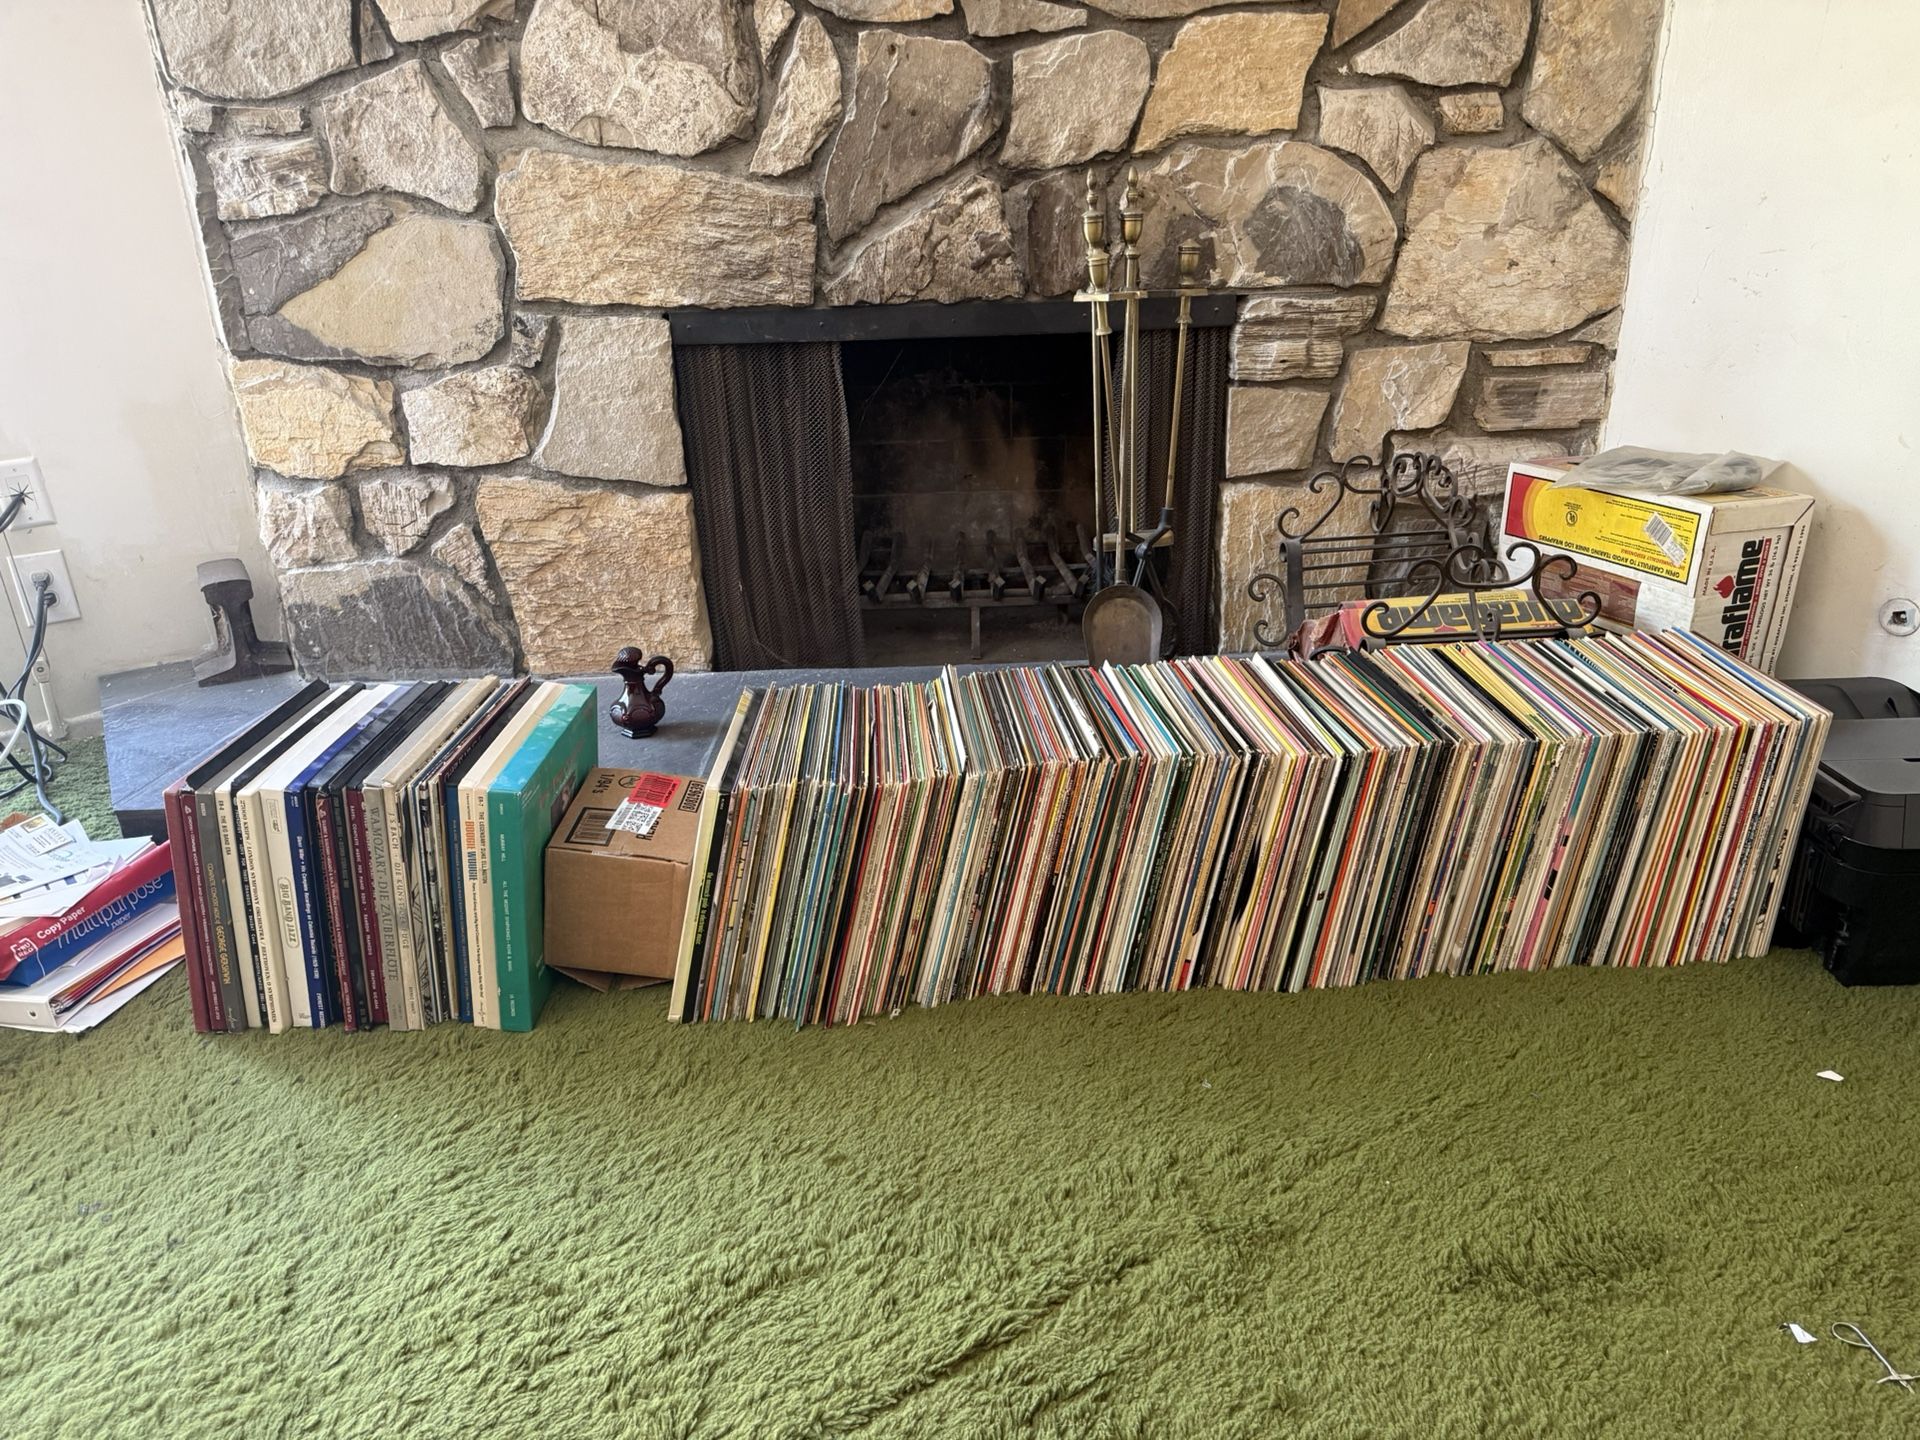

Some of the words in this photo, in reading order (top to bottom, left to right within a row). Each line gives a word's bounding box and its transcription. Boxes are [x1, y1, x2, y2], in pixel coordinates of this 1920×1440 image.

[1538, 534, 1563, 546] WRAPPERS
[1563, 540, 1574, 548] LOG
[1574, 543, 1590, 553] INNER
[1590, 548, 1611, 559] TEARING
[1611, 553, 1628, 563] AVOID
[1636, 560, 1664, 573] CAREFULLY
[1664, 568, 1680, 578] OPEN
[1701, 576, 1709, 595] MADE
[1706, 567, 1711, 575] IN
[1722, 540, 1764, 656] raflame
[465, 821, 476, 849] BOOGIE
[207, 863, 216, 886] COMPLETE
[467, 851, 478, 880] WOOGIE
[210, 886, 218, 906] CONCERT
[279, 882, 290, 898] BIG
[377, 880, 389, 900] DIE
[390, 826, 398, 849] BACH
[395, 879, 404, 907] KUNST
[400, 928, 409, 949] FUGE
[58, 876, 163, 949] multipurpose
[110, 912, 131, 930] paper
[281, 898, 293, 922] BAND
[36, 923, 62, 940] Copy
[62, 906, 86, 925] Paper
[246, 846, 254, 870] LONDON
[250, 872, 259, 904] SYMPHONY
[255, 906, 265, 940] ORCHESTRA
[267, 986, 277, 1022] SYMPHONIES
[286, 922, 296, 942] JAZZ
[215, 924, 226, 952] GEORGE
[380, 903, 399, 982] ZAUBERFLÖTE
[219, 952, 230, 984] GERSHWIN
